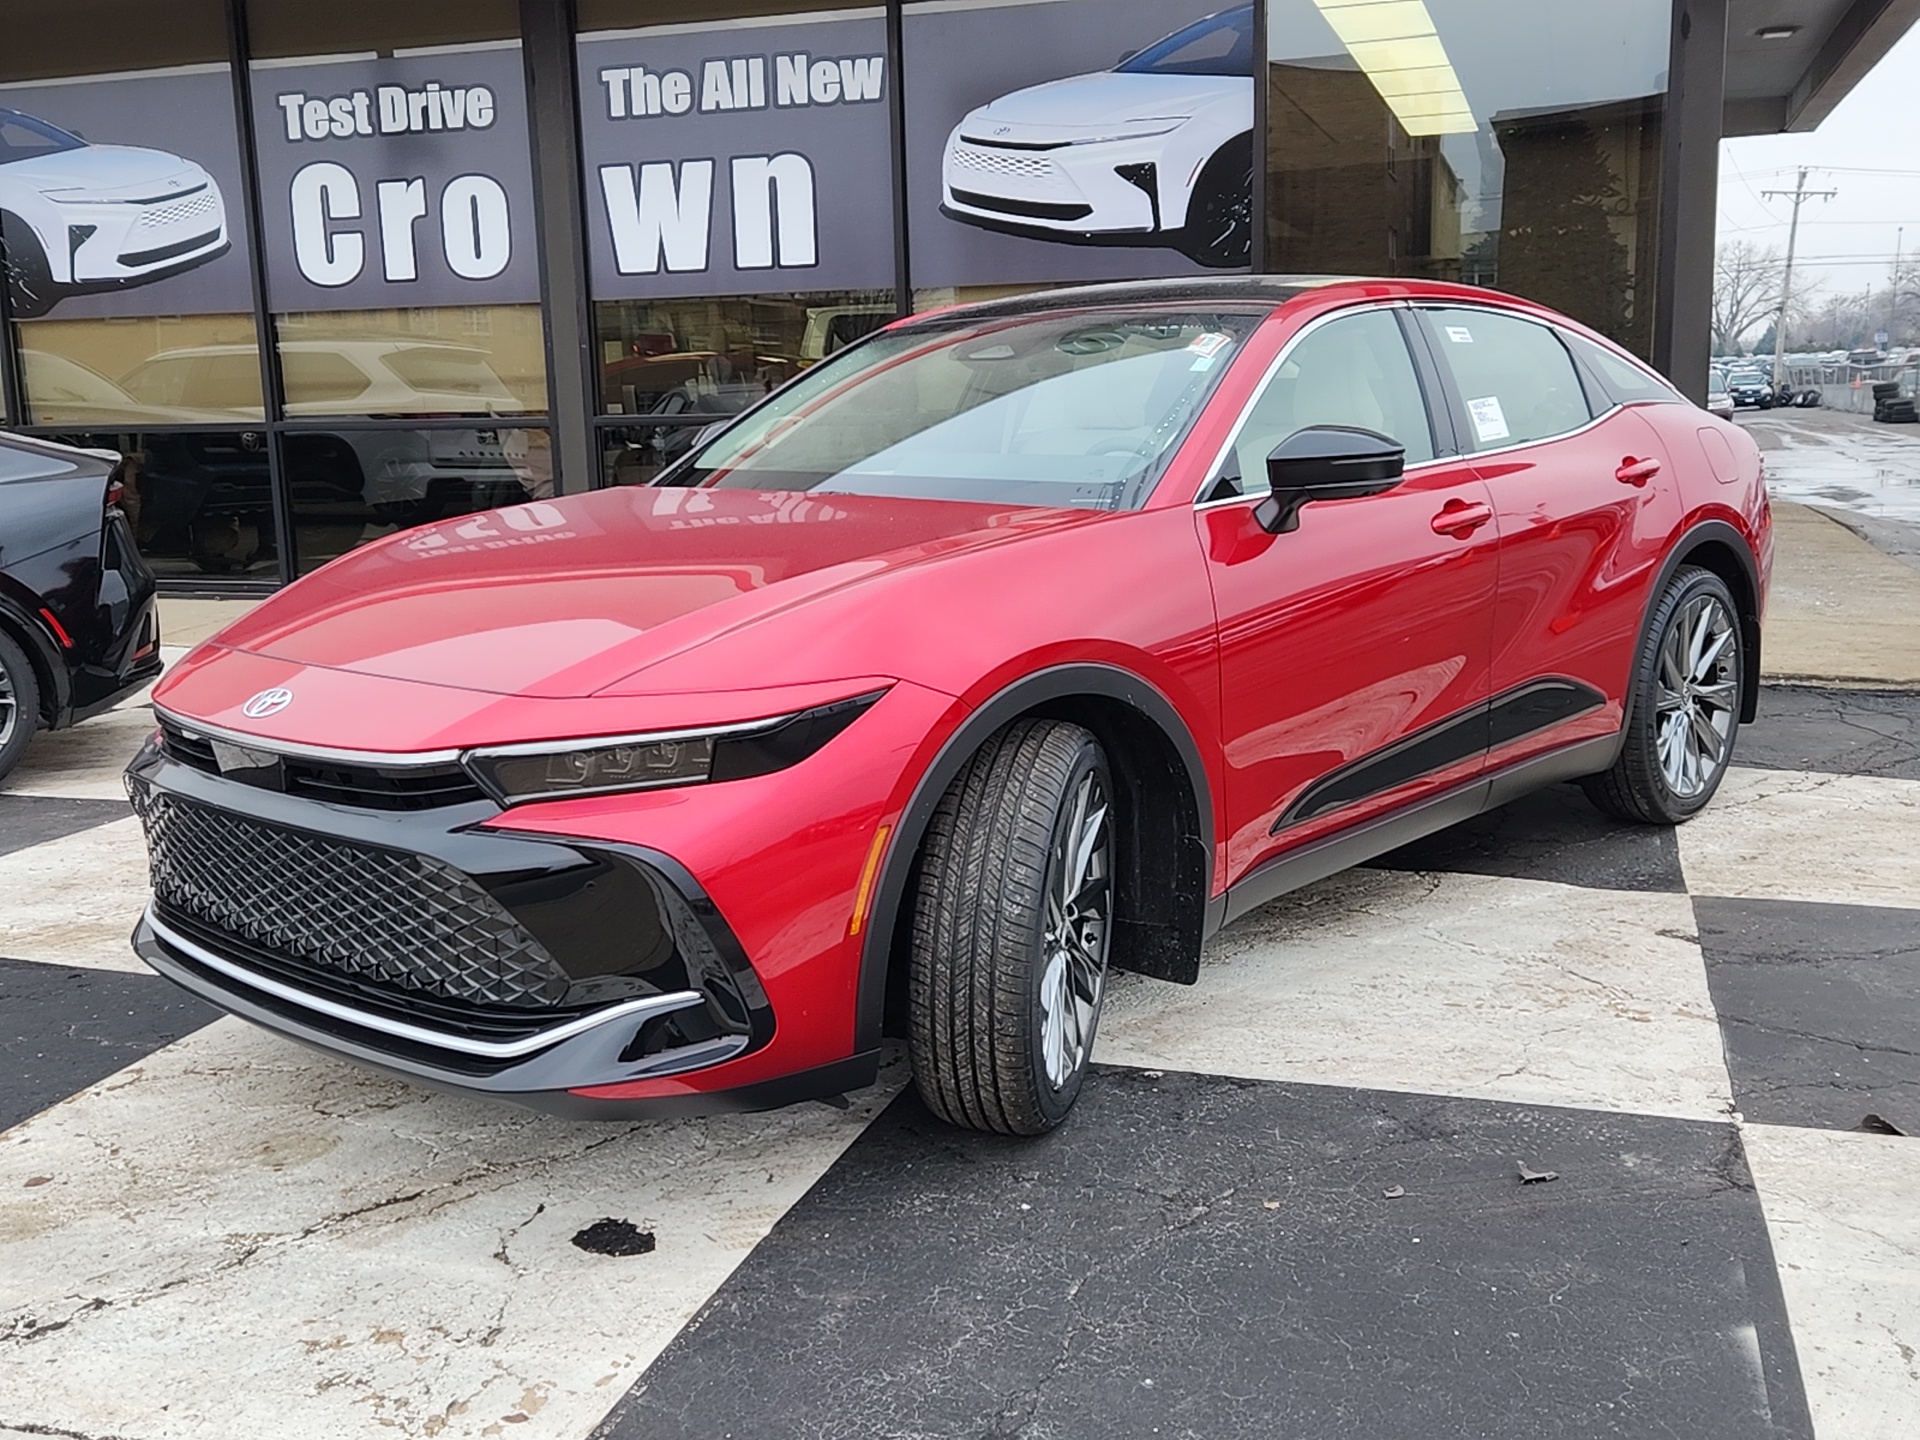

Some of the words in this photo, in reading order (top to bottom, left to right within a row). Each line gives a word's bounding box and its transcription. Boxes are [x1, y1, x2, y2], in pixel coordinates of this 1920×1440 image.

[278, 91, 373, 140] Test
[377, 82, 495, 133] Drive
[600, 66, 692, 118] The
[700, 57, 766, 111] All
[775, 53, 884, 105] New
